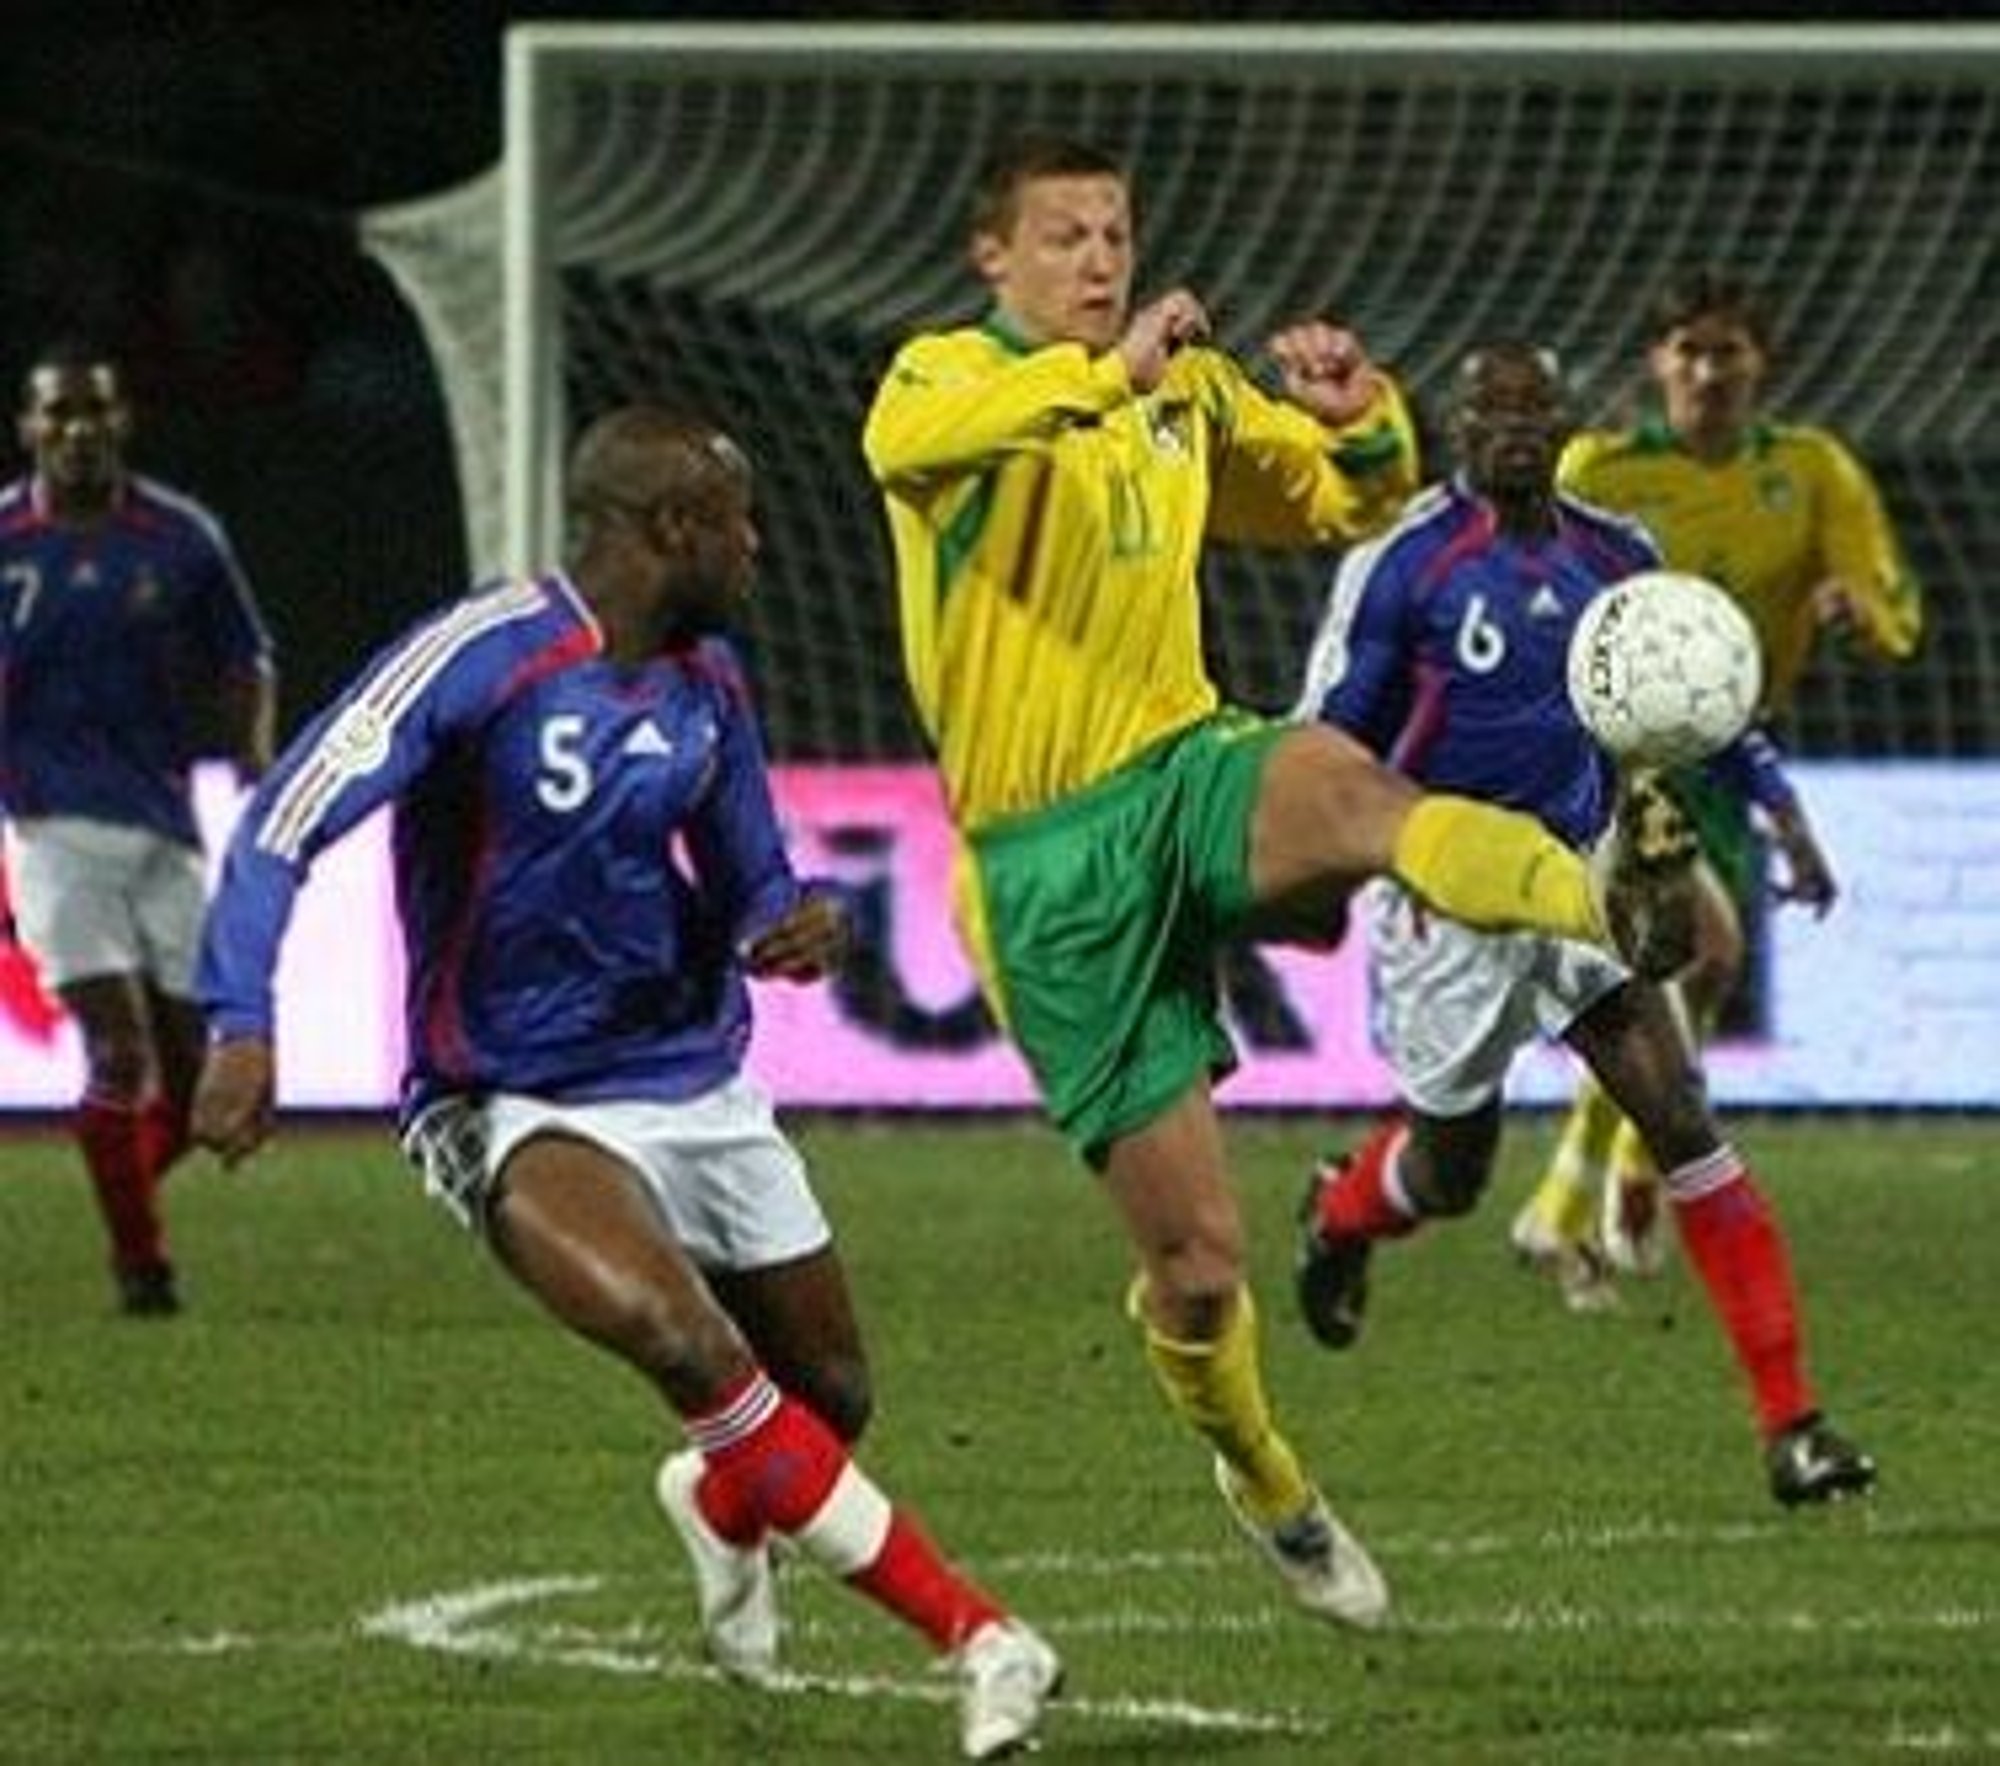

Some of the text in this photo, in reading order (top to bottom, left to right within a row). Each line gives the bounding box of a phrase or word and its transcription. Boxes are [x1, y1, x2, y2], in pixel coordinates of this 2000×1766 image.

[1, 563, 41, 630] 7
[1458, 595, 1504, 672] 6
[537, 713, 592, 812] 5
